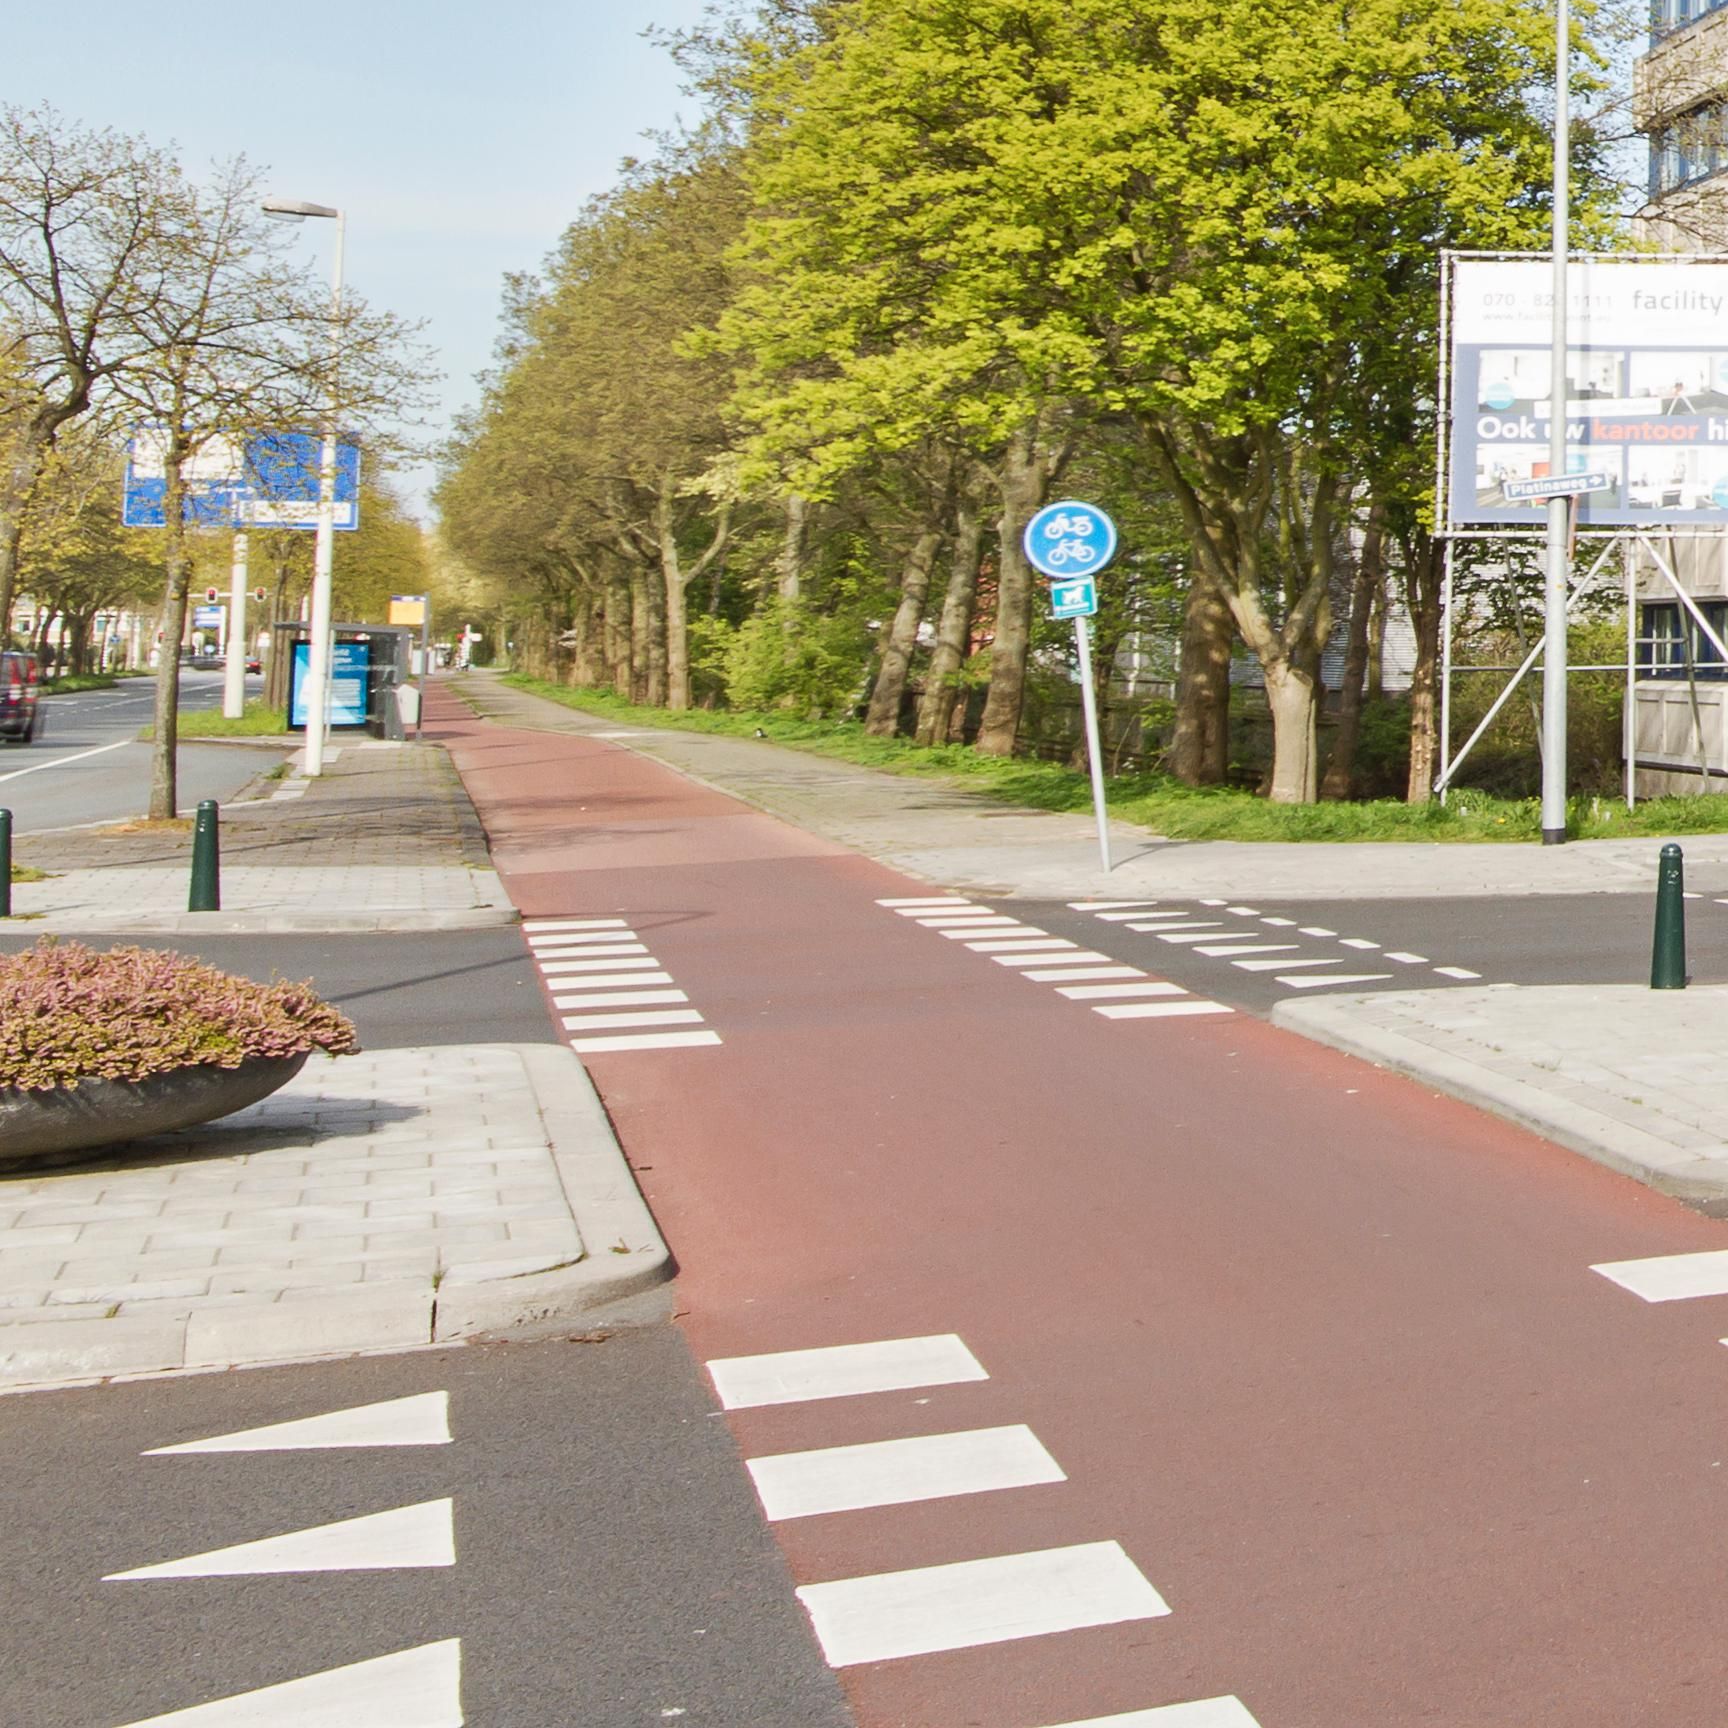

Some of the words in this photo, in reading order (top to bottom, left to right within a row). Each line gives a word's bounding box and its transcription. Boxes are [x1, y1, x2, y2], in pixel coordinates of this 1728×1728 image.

[1477, 416, 1536, 439] Ook
[1592, 418, 1700, 441] kantoor
[1510, 477, 1588, 496] Platinaweg
